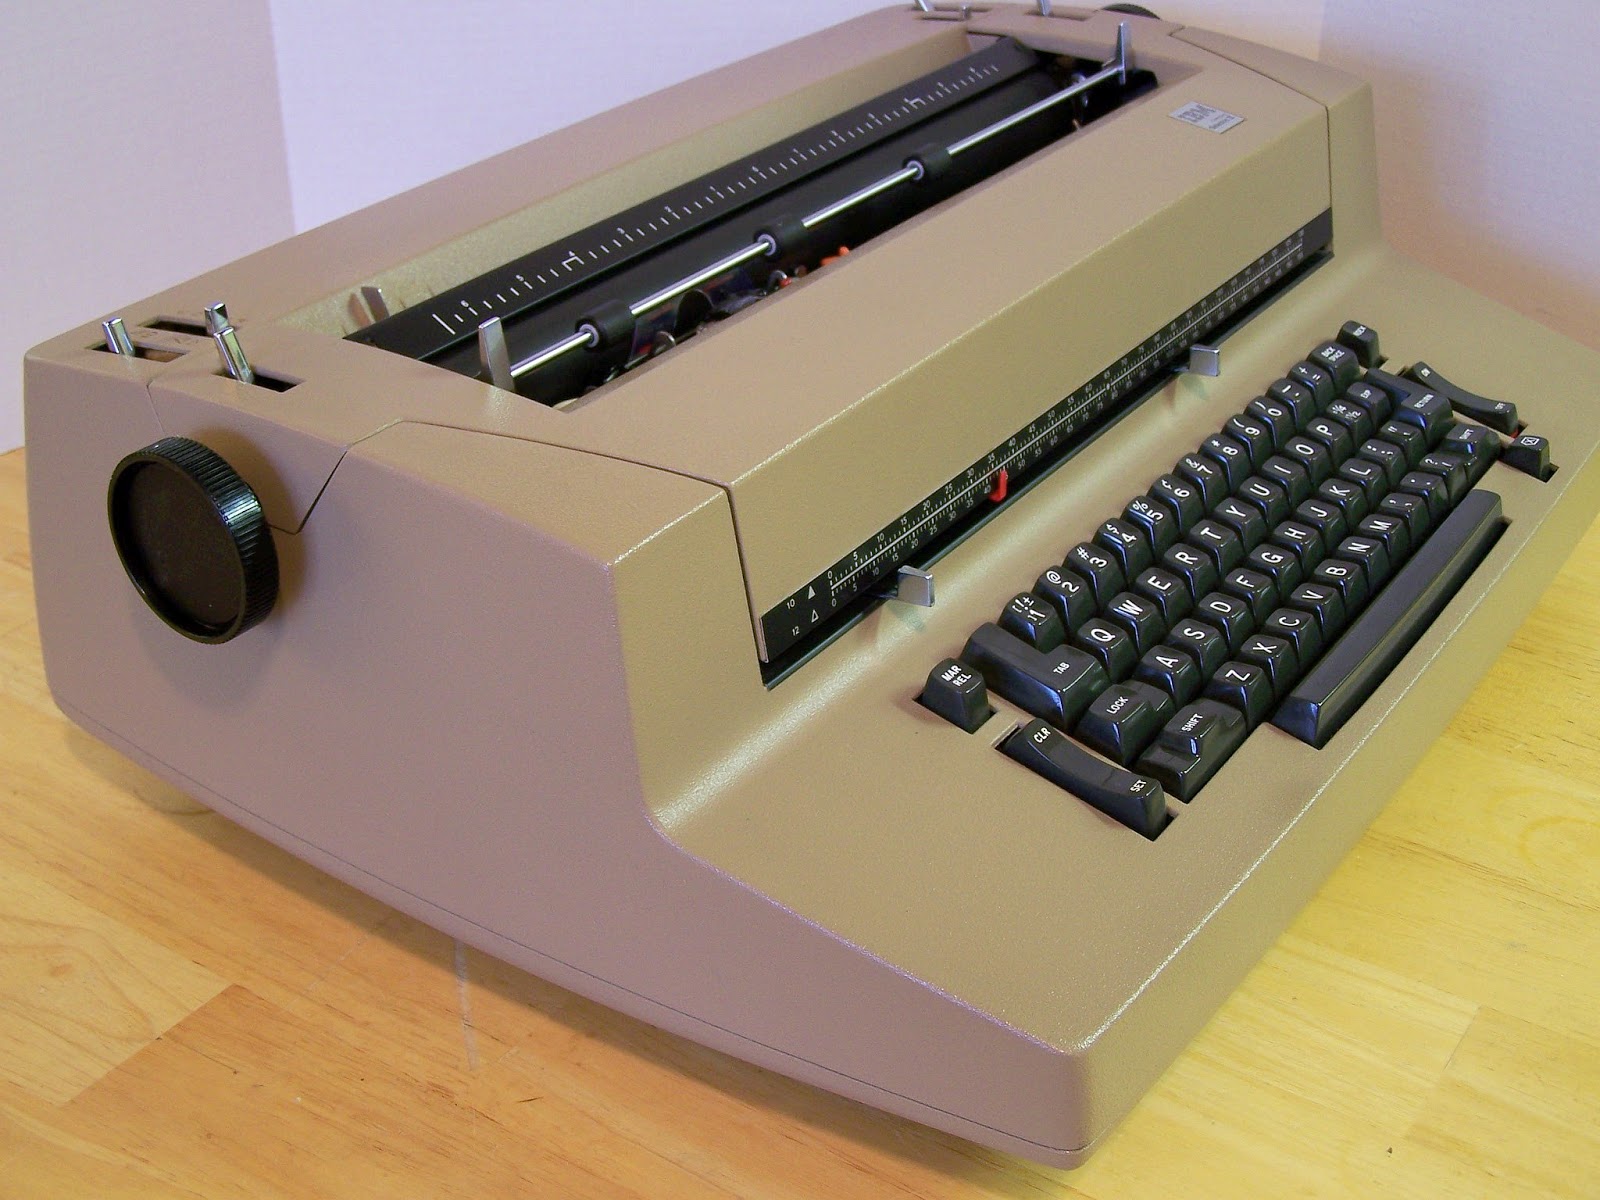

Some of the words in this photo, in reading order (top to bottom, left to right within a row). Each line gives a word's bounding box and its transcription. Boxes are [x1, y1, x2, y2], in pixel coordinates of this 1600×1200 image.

[1267, 408, 1282, 417] 0
[1244, 426, 1261, 436] 9
[1316, 425, 1333, 436] P
[1222, 446, 1238, 456] 8
[1295, 444, 1314, 455] O
[1185, 458, 1200, 469] &
[1197, 464, 1213, 475] 7
[1274, 464, 1291, 475] I
[1350, 467, 1371, 476] L
[1174, 487, 1190, 498] 6
[1250, 483, 1271, 496] U
[1329, 485, 1350, 497] K
[1133, 500, 1149, 513] %
[1226, 505, 1246, 518] Y
[1310, 506, 1328, 518] J
[827, 570, 834, 580] 0
[853, 552, 859, 561] 5
[876, 533, 885, 543] 10
[900, 516, 908, 526] 15
[923, 500, 931, 510] 20
[945, 483, 953, 494] 25
[967, 468, 974, 478] 30
[988, 453, 995, 463] 35
[1147, 510, 1164, 521] 5
[1106, 523, 1120, 535] $
[1369, 520, 1392, 531] M
[831, 598, 837, 608] 0
[852, 583, 858, 592] 5
[872, 566, 880, 577] 10
[892, 553, 899, 563] 15
[911, 538, 919, 549] 20
[929, 524, 938, 535] 25
[949, 510, 956, 521] 30
[966, 498, 974, 508] 35
[983, 485, 992, 494] 40
[1017, 459, 1026, 469] 50
[1120, 531, 1137, 543] 4
[1201, 527, 1222, 540] T
[1284, 527, 1306, 540] H
[1076, 546, 1090, 560] #
[1348, 542, 1371, 553] N
[1089, 556, 1108, 568] 3
[1175, 551, 1198, 565] R
[1261, 552, 1284, 564] G
[1046, 571, 1061, 584] @
[1325, 566, 1348, 577] B
[1062, 581, 1080, 593] 2
[1147, 576, 1171, 591] E
[1236, 574, 1254, 589] F
[1302, 589, 1324, 602] V
[787, 599, 796, 609] 10
[1119, 600, 1144, 616] W
[1209, 601, 1232, 613] D
[1278, 616, 1300, 628] C
[791, 626, 800, 636] 12
[1091, 628, 1116, 642] Q
[1183, 627, 1206, 640] S
[1253, 640, 1278, 654] X
[1155, 654, 1179, 669] A
[941, 665, 962, 682] MAR
[1053, 662, 1070, 674] TAB
[954, 672, 972, 687] REL
[1225, 668, 1250, 682] Z
[1107, 696, 1129, 715] LOCK
[1181, 713, 1204, 732] SHIFT
[1034, 727, 1051, 744] CLR
[1130, 779, 1147, 793] SET
